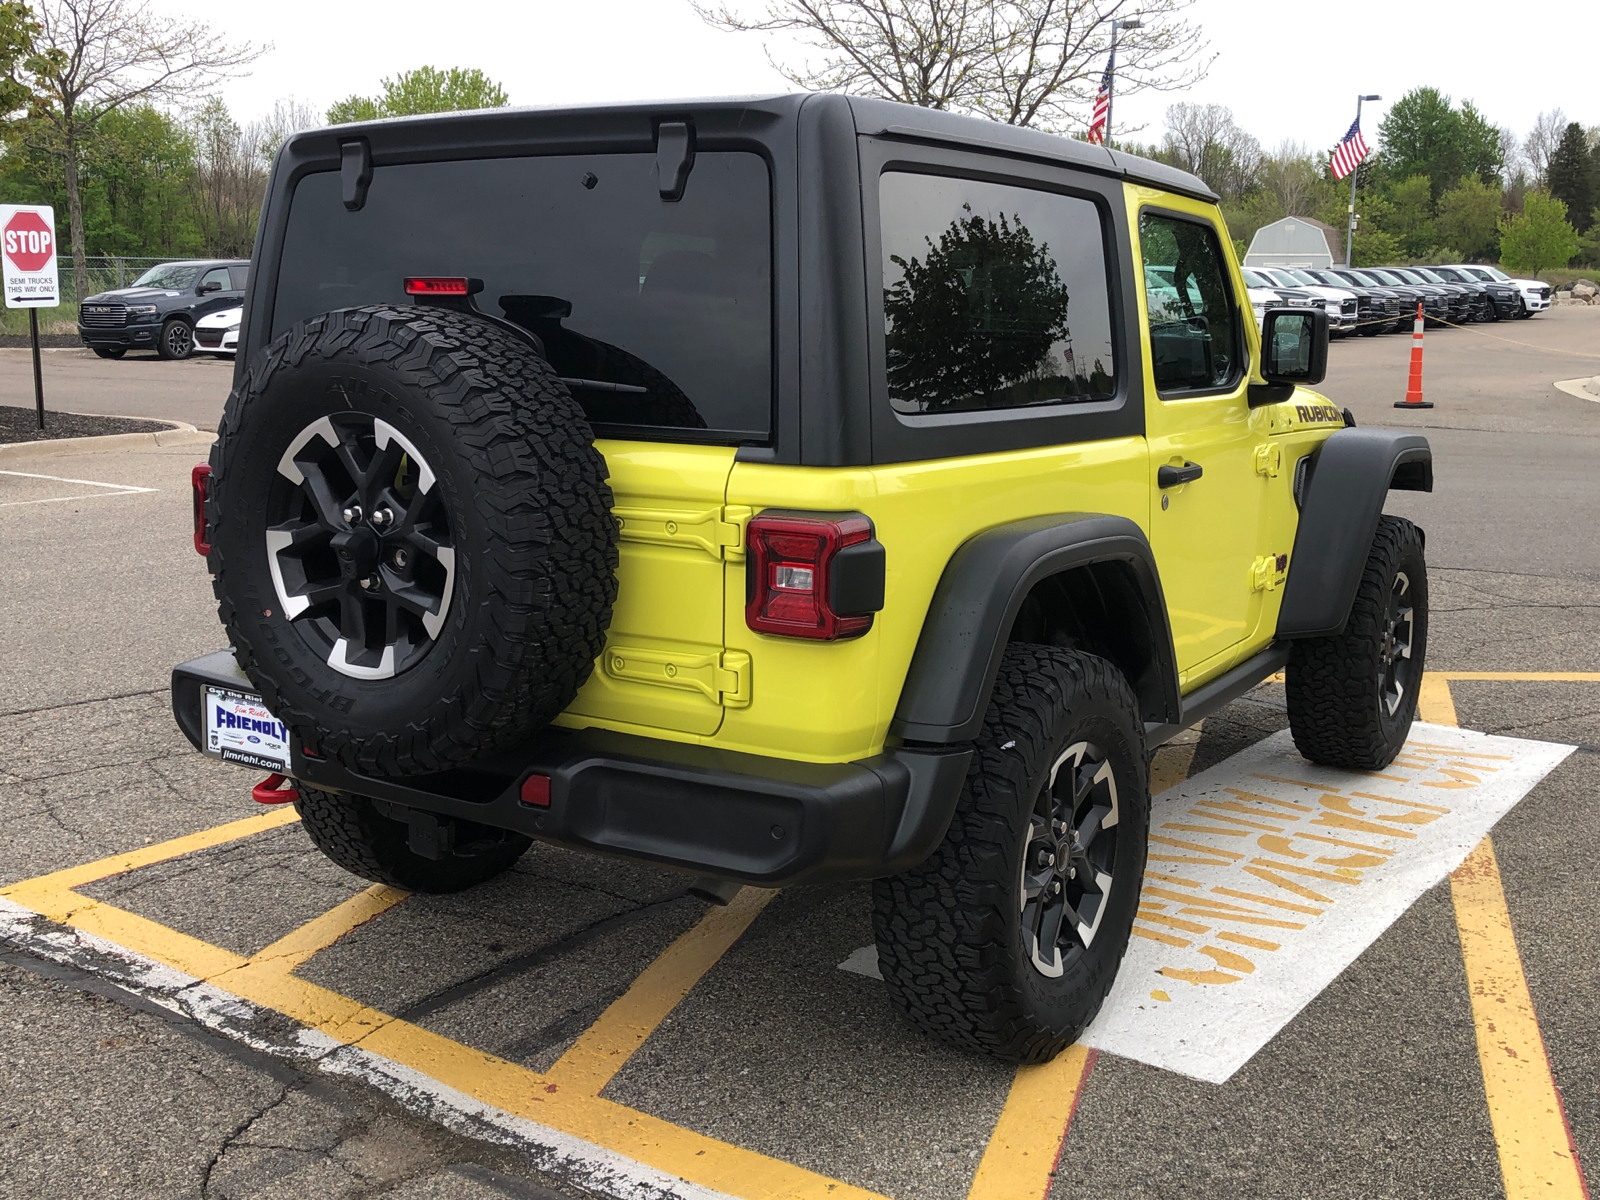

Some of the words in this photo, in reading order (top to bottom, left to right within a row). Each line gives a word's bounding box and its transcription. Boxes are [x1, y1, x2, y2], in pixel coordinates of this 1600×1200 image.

[6, 230, 51, 254] STOP
[1295, 405, 1343, 423] RUBICON
[208, 687, 225, 696] Get
[227, 690, 242, 699] the
[234, 705, 247, 715] Jim
[248, 707, 269, 719] Riehl's
[216, 704, 287, 744] FRIENDLY
[222, 749, 281, 770] jimriehl.com
